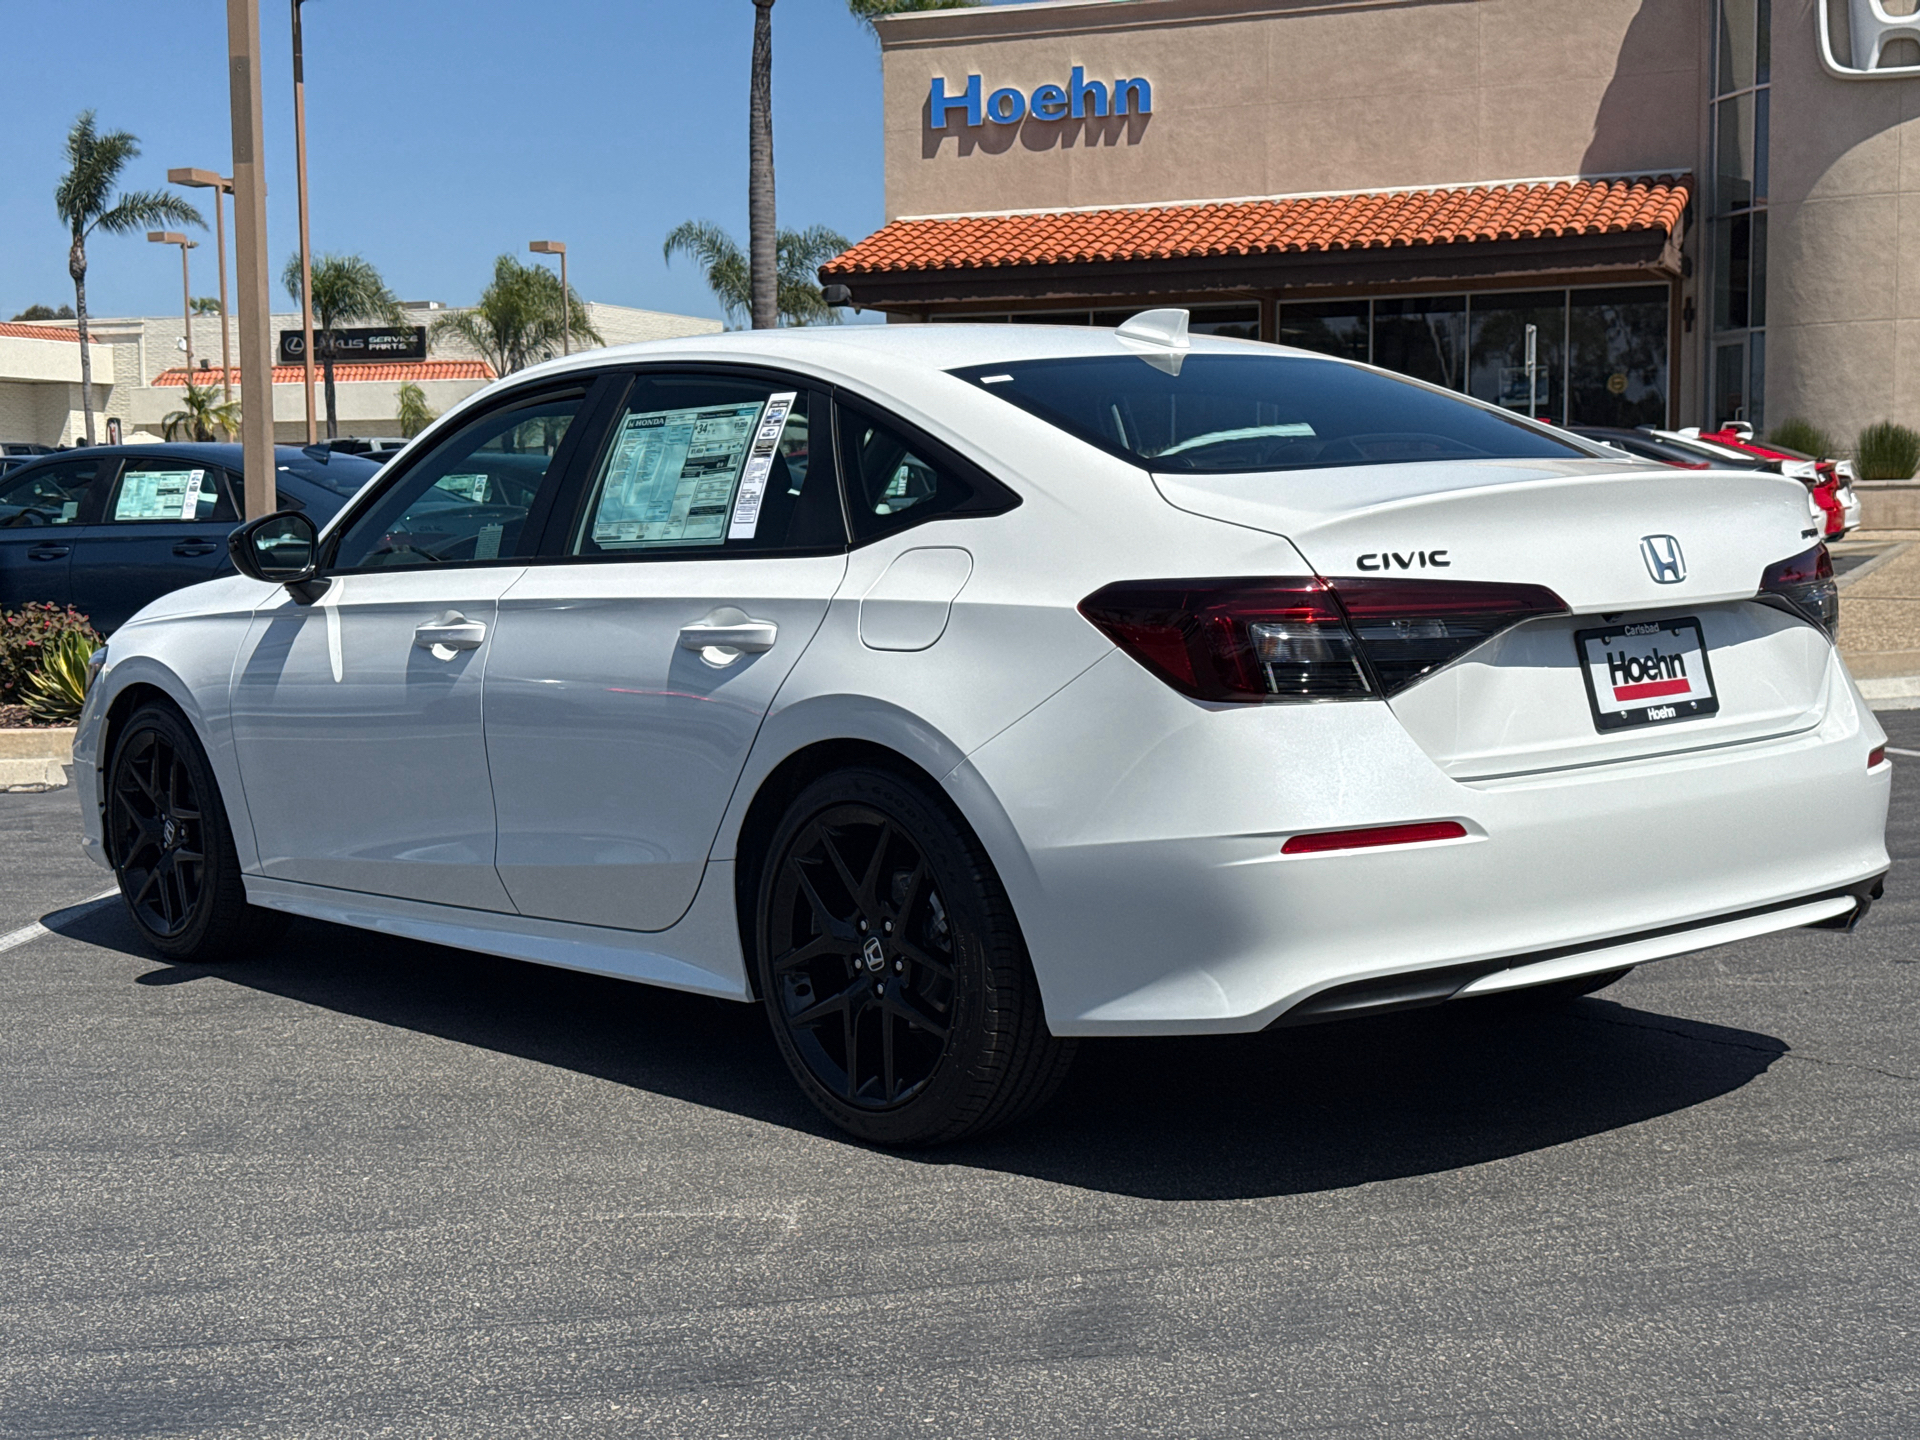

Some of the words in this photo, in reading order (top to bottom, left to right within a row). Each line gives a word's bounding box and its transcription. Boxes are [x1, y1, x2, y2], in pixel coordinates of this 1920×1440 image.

[930, 65, 1152, 129] Hoehn
[634, 419, 665, 427] HONDA
[1356, 550, 1451, 572] CIVIC
[1624, 622, 1660, 636] Carlsbad
[1606, 648, 1687, 685] Hoehn
[1647, 706, 1676, 721] Hoehn
